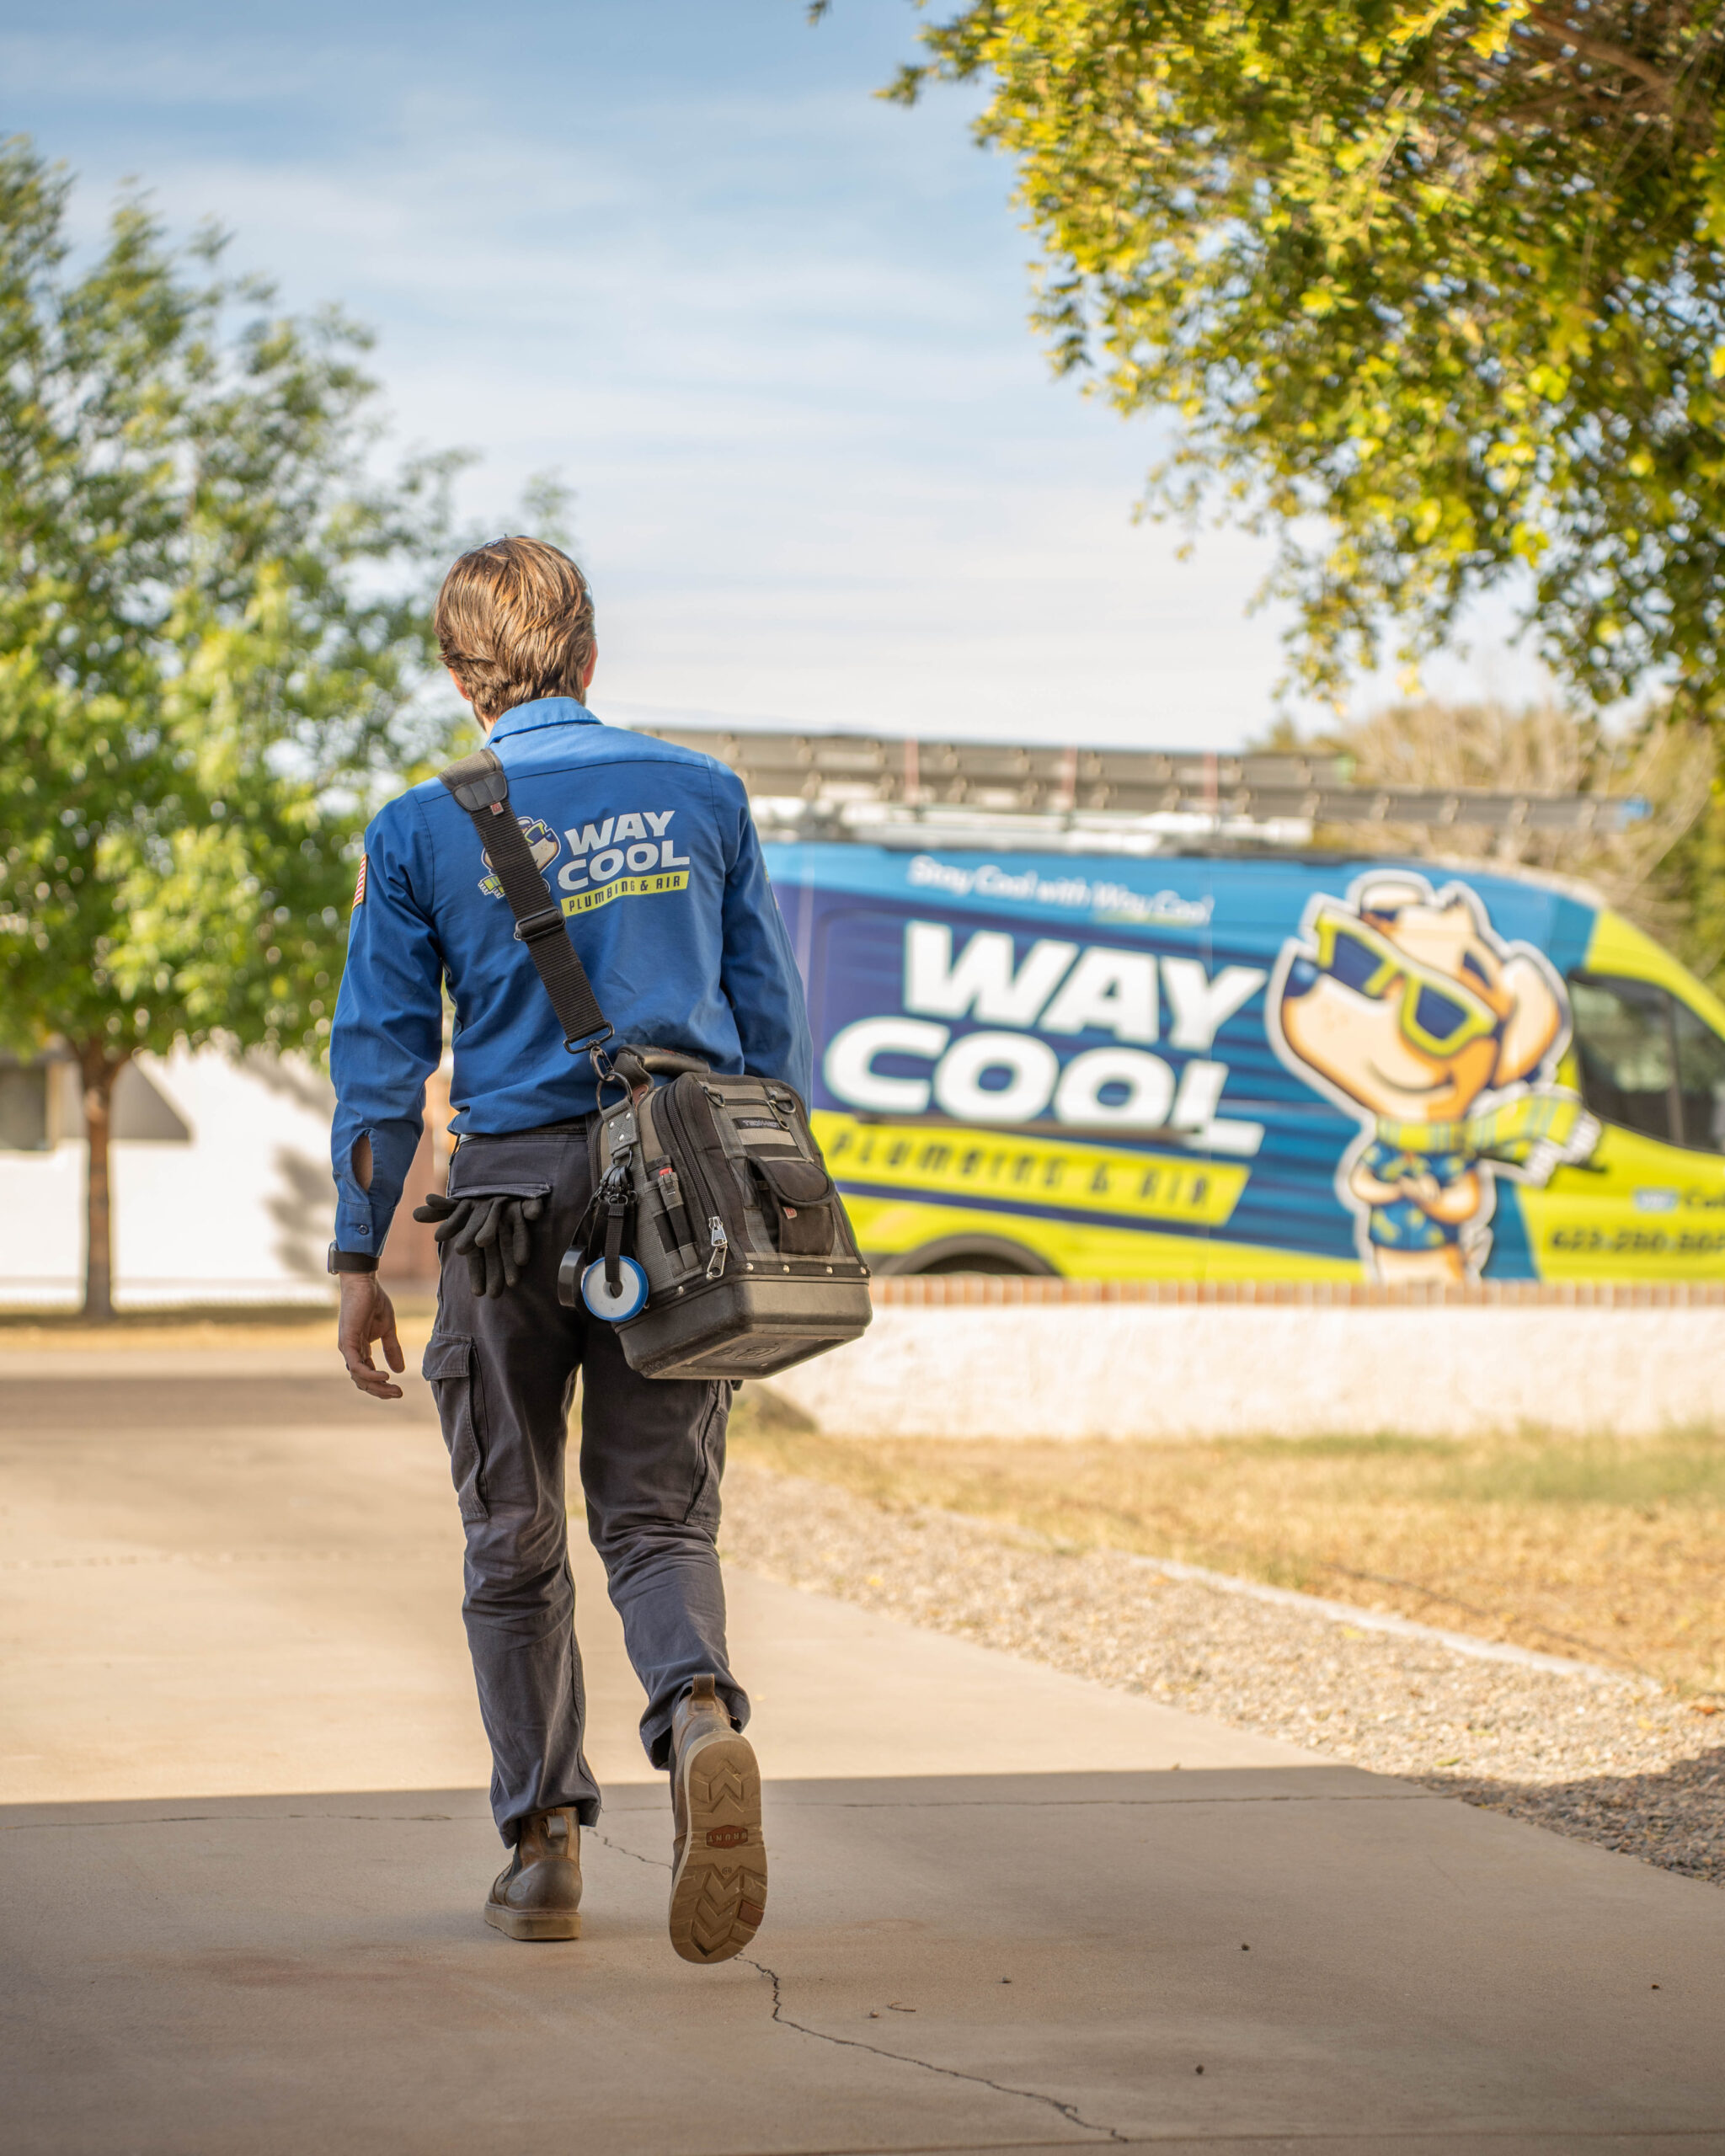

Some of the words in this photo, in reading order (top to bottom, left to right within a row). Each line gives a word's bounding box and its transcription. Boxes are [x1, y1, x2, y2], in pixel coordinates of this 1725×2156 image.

[563, 810, 675, 857] WAY
[558, 840, 690, 891] COOL
[569, 879, 635, 912] PLUMBING
[640, 879, 649, 892] &
[656, 875, 681, 889] AIR
[907, 855, 973, 897] Stay
[974, 865, 1038, 900] Cool
[1036, 877, 1091, 906] with
[1092, 880, 1151, 916] Way
[904, 920, 1268, 1052] WAY
[824, 1016, 1265, 1156] COOL
[830, 1129, 1067, 1191] PLUMBING
[1088, 1164, 1112, 1195] &
[1139, 1168, 1210, 1209] AIR
